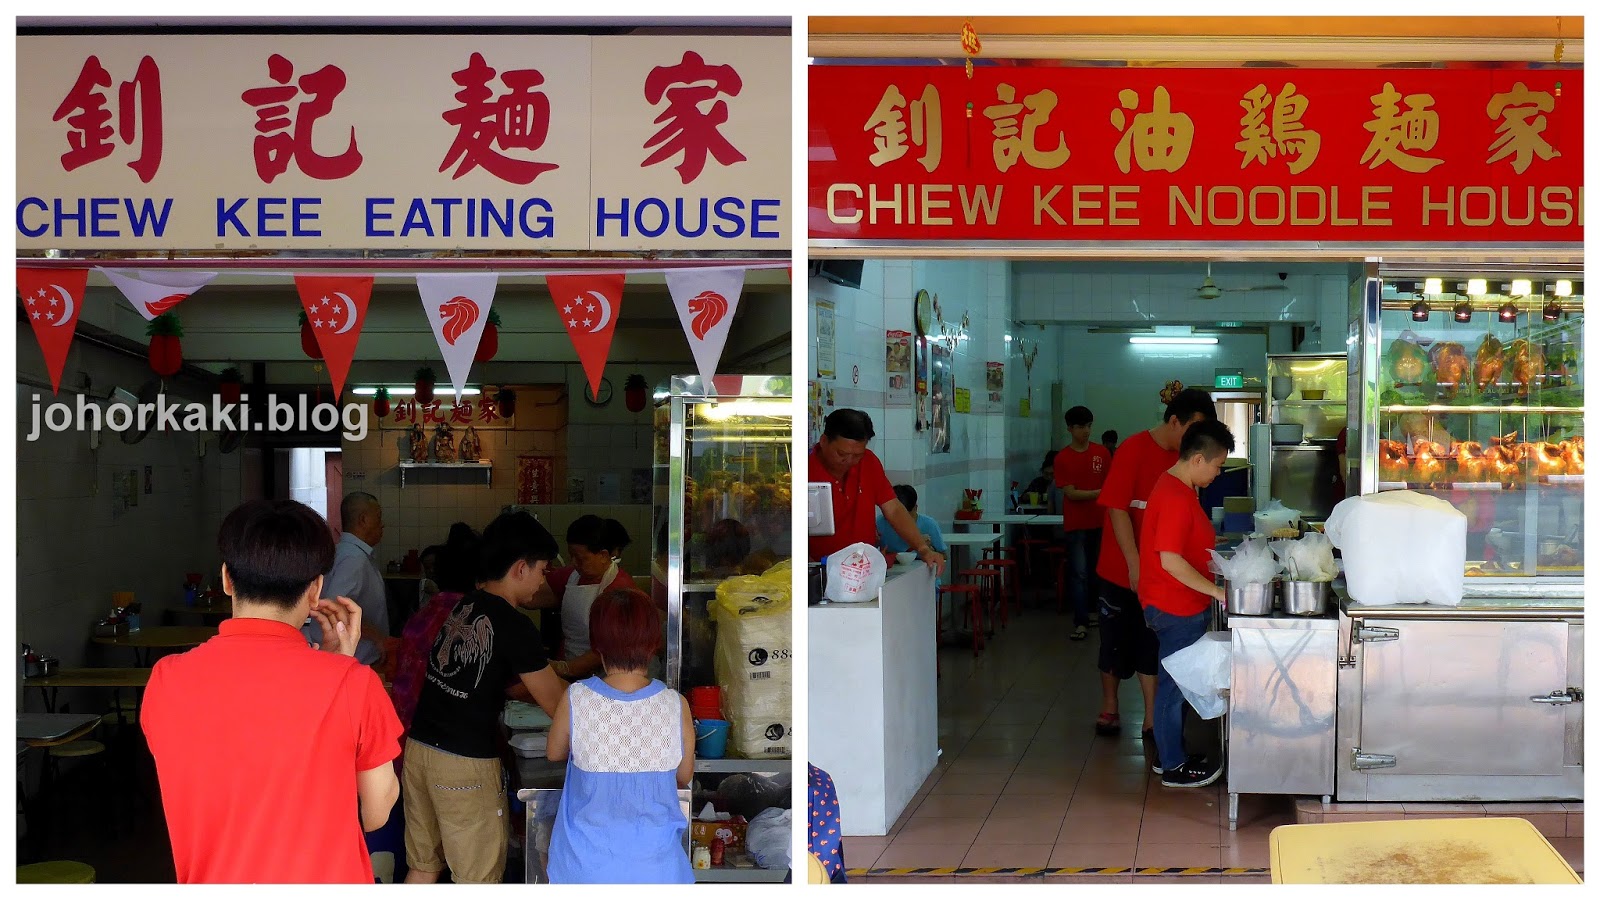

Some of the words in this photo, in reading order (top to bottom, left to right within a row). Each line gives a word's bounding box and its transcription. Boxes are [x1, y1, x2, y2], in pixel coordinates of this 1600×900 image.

[17, 197, 173, 238] CHEW
[217, 198, 322, 237] KEE
[365, 197, 555, 239] EATING
[596, 197, 781, 239] HOUSE
[826, 184, 1004, 226] CHIEW
[1033, 185, 1140, 226] KEE
[1168, 185, 1393, 226] NOODLE
[1422, 185, 1584, 226] HOUS
[1220, 377, 1237, 386] EXIT
[771, 649, 792, 660] 88
